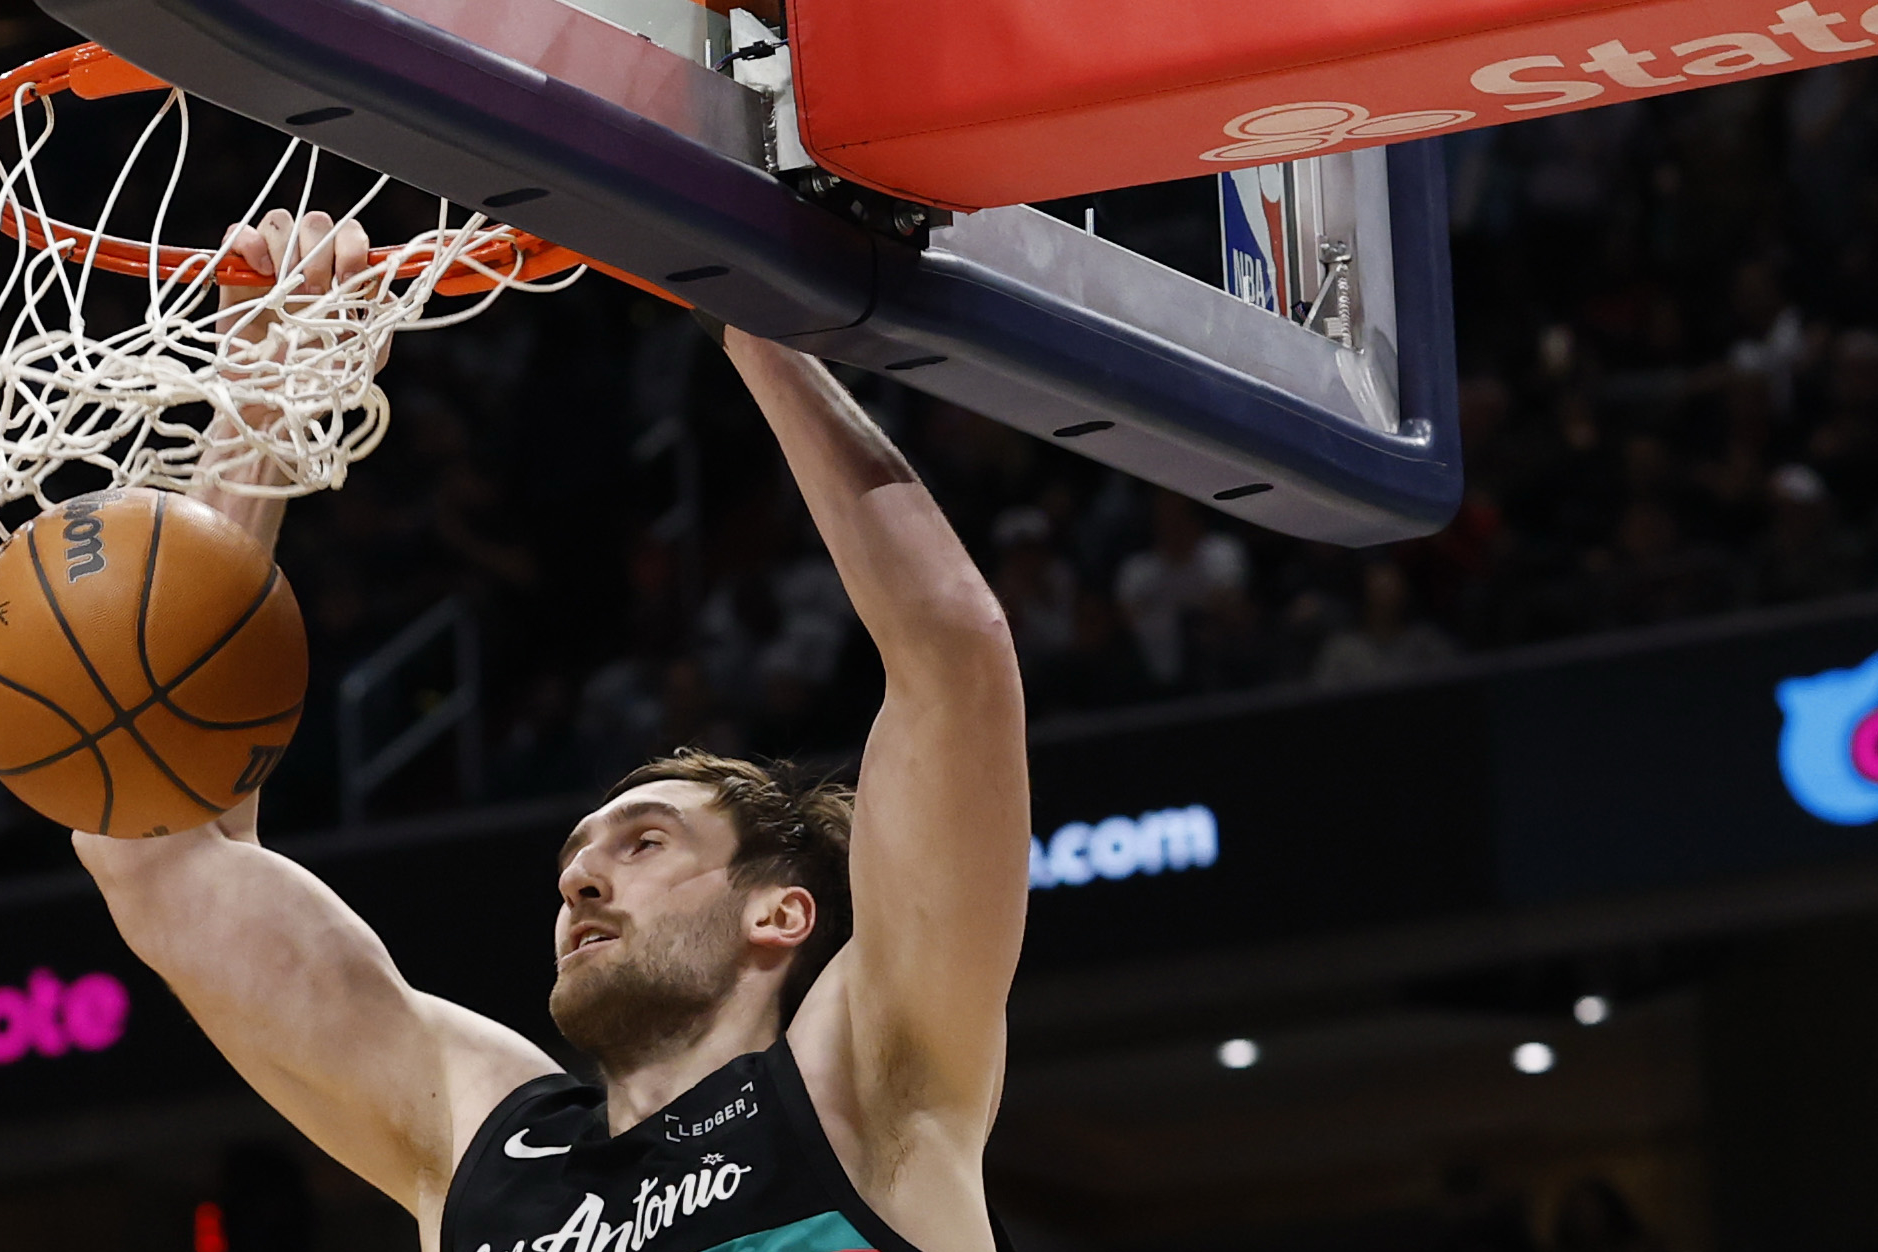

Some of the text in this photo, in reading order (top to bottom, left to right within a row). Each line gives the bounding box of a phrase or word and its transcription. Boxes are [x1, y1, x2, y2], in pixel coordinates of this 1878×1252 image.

[1469, 0, 1878, 112] Stat
[1028, 804, 1219, 891] .com
[677, 1097, 747, 1138] LEDGER
